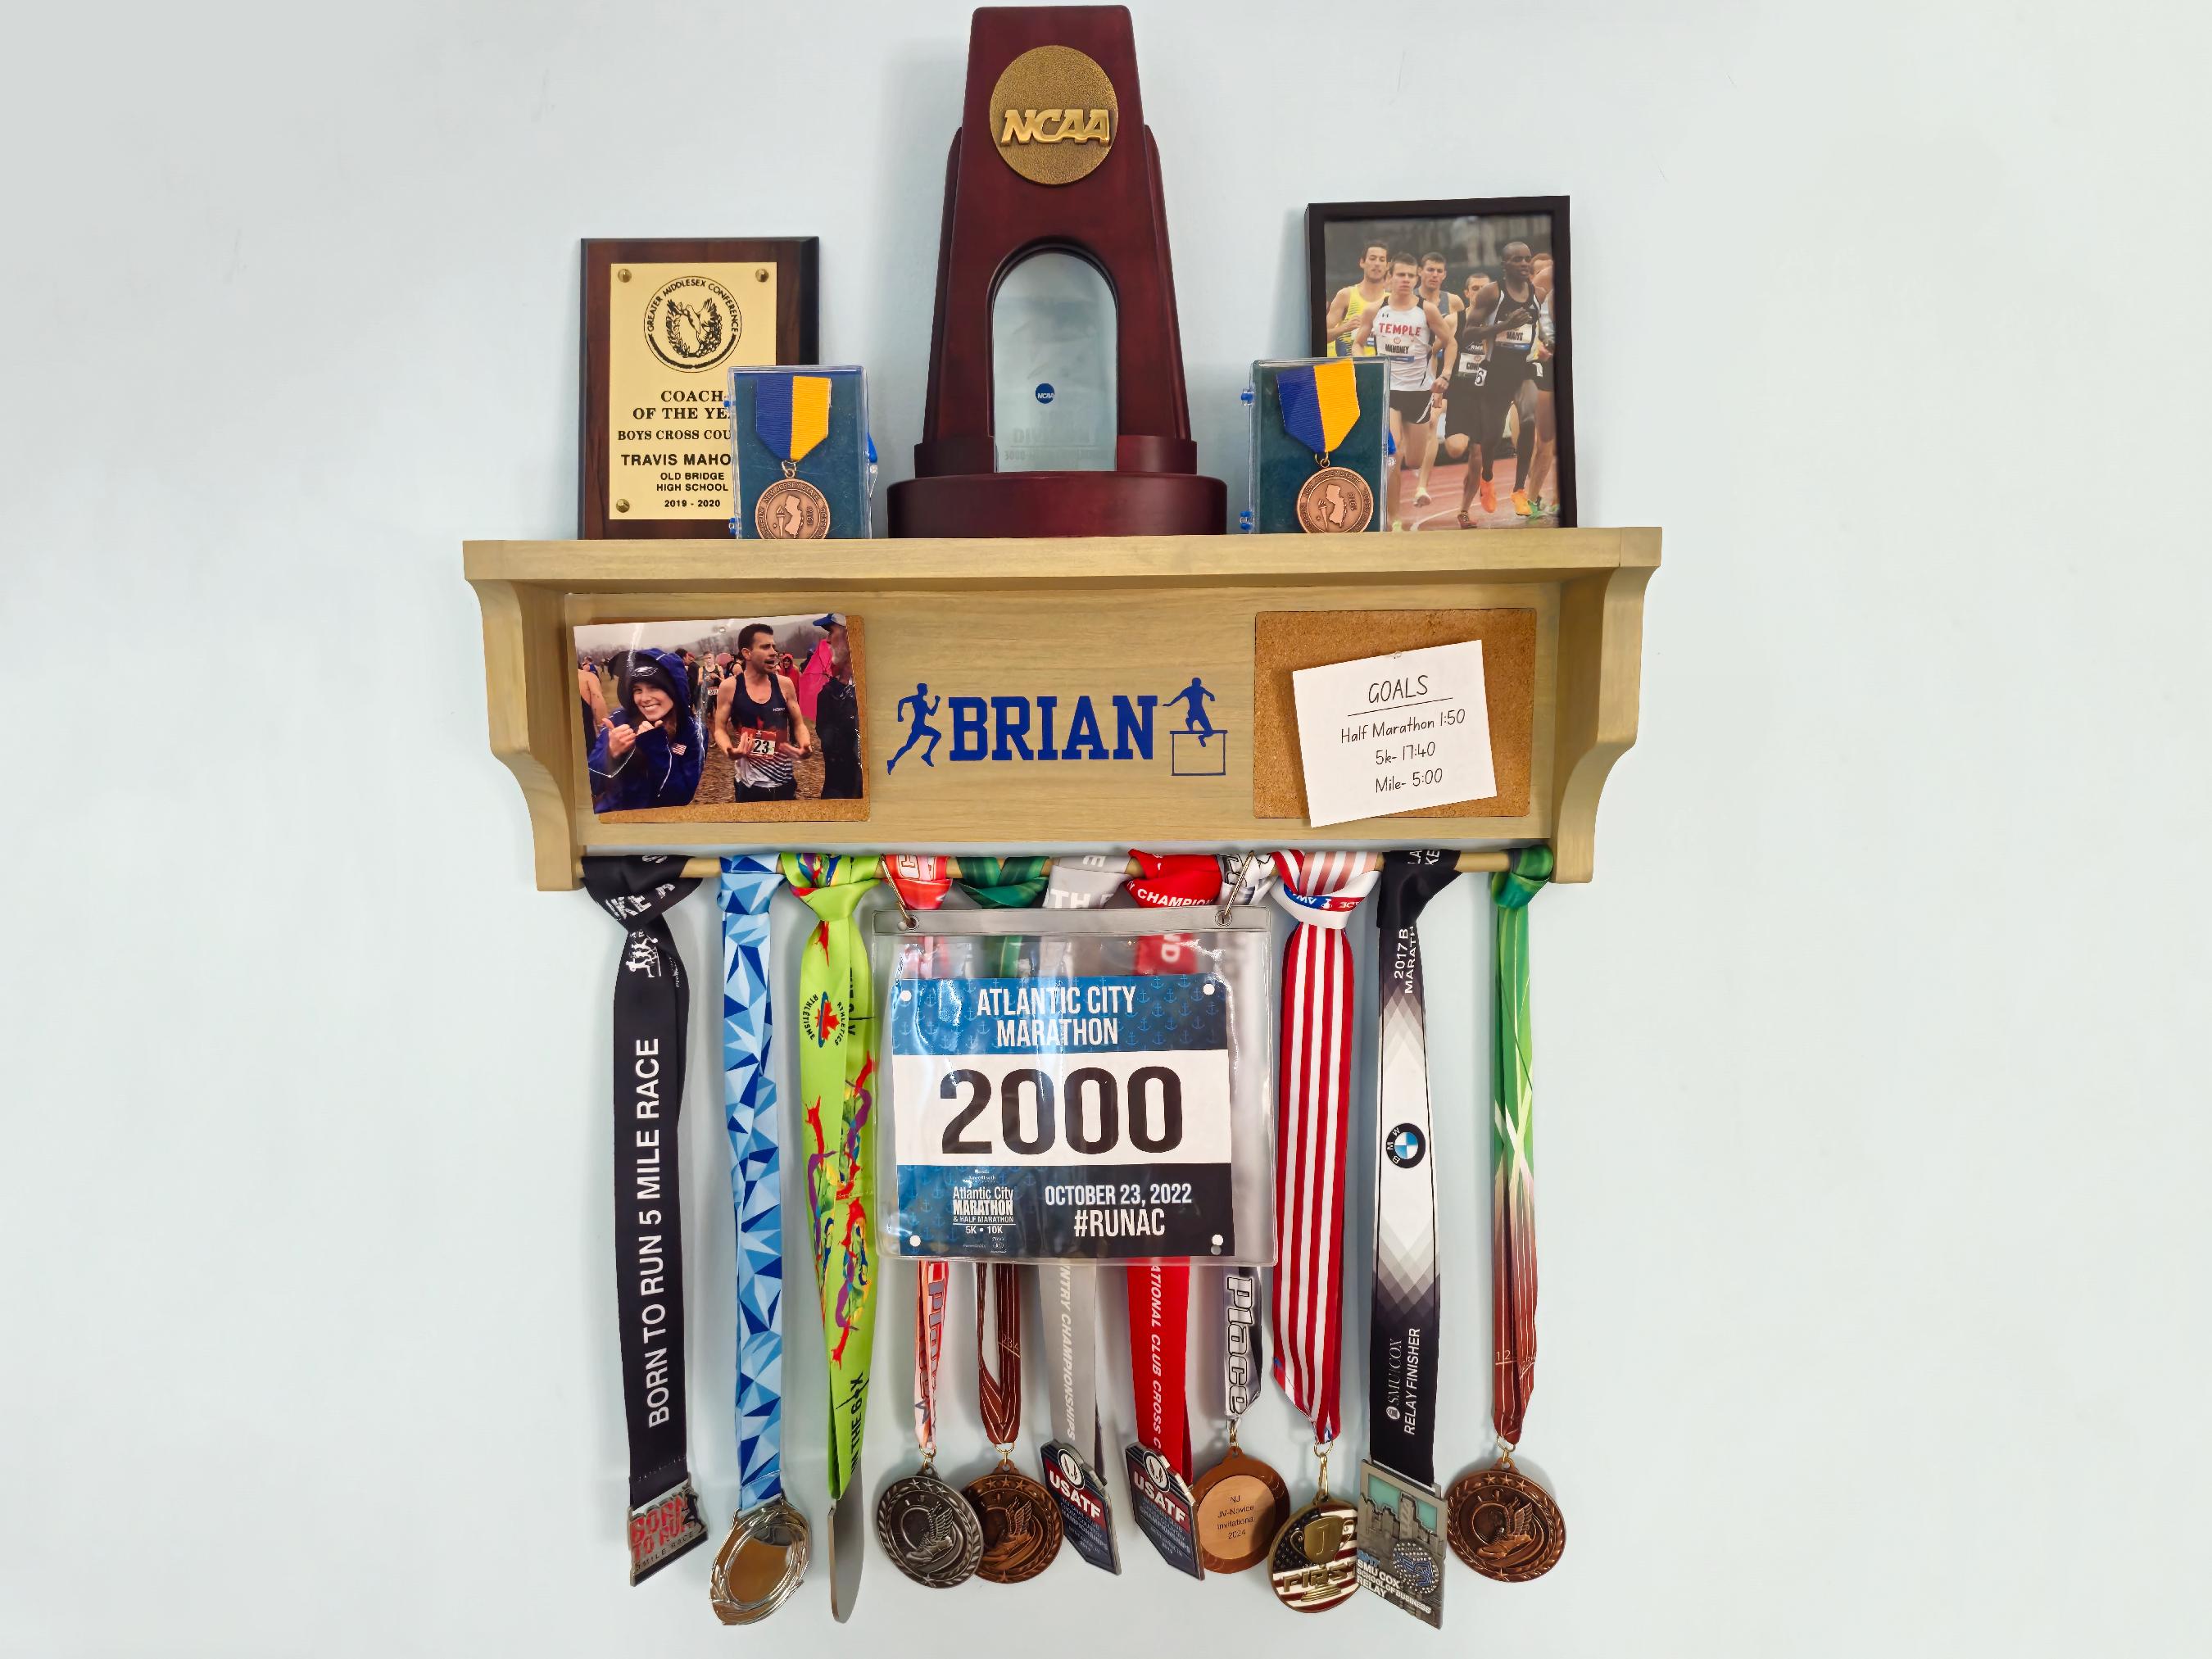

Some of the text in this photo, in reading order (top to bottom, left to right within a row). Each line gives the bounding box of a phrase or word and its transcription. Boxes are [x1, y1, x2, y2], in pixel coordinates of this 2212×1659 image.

[1000, 108, 1111, 146] NCAA
[647, 279, 739, 333] GREATER MIDDLESEX CONFERENCE
[1379, 323, 1421, 337] TEMPLE
[1385, 343, 1410, 355] MAHONEY
[661, 391, 723, 401] COACH
[632, 408, 730, 419] OF THE YE
[618, 430, 731, 440] BOYS CROSS COU
[621, 453, 732, 466] TRAVIS MAHO
[656, 483, 728, 492] HIGH SCHOOL
[763, 483, 820, 503] NEW JERSEY STATE
[664, 500, 687, 508] 2019
[698, 499, 721, 507] 2020
[1368, 675, 1429, 704] GOALS
[948, 695, 1158, 761] BRIAN
[1341, 709, 1466, 744] Half Marathon 1:50
[754, 740, 770, 754] 23
[1376, 741, 1435, 764] 5k- 17:40
[1376, 768, 1443, 793] Mile- 5:00
[1394, 928, 1409, 979] 2017 B
[977, 986, 1136, 1017] ATLANTIC CITY
[835, 1001, 845, 1046] ATHLETICS
[997, 1018, 1119, 1048] MARATHON
[940, 1066, 1183, 1155] 2000
[1386, 1127, 1401, 1164] BMW
[953, 1186, 1014, 1201] Atlantic City
[953, 1200, 1013, 1216] MARATHON
[1045, 1183, 1192, 1207] OCTOBER 23, 2022
[635, 1038, 669, 1429] BORN TO RUN 5 MILE RACE
[965, 1226, 1004, 1234] 5K 10K
[1074, 1208, 1165, 1237] #RUNAC
[1150, 1264, 1162, 1328] ATIONAL
[1151, 1334, 1162, 1376] CLUB
[1226, 1276, 1253, 1415] Place
[1061, 1314, 1077, 1440] CHAMPIONSHIPS
[1403, 1327, 1421, 1435] RELAY FINISHER
[1152, 1380, 1163, 1435] CROSS
[851, 1412, 862, 1453] THE
[1049, 1470, 1101, 1518] USATF
[1134, 1471, 1185, 1521] USATF
[1230, 1495, 1240, 1503] NJ
[1217, 1506, 1254, 1518] JV-Novice
[1357, 1559, 1401, 1589] SMU COX
[1357, 1575, 1387, 1598] RELAY
[1357, 1567, 1432, 1615] SCHOOL OF BUSINESS
